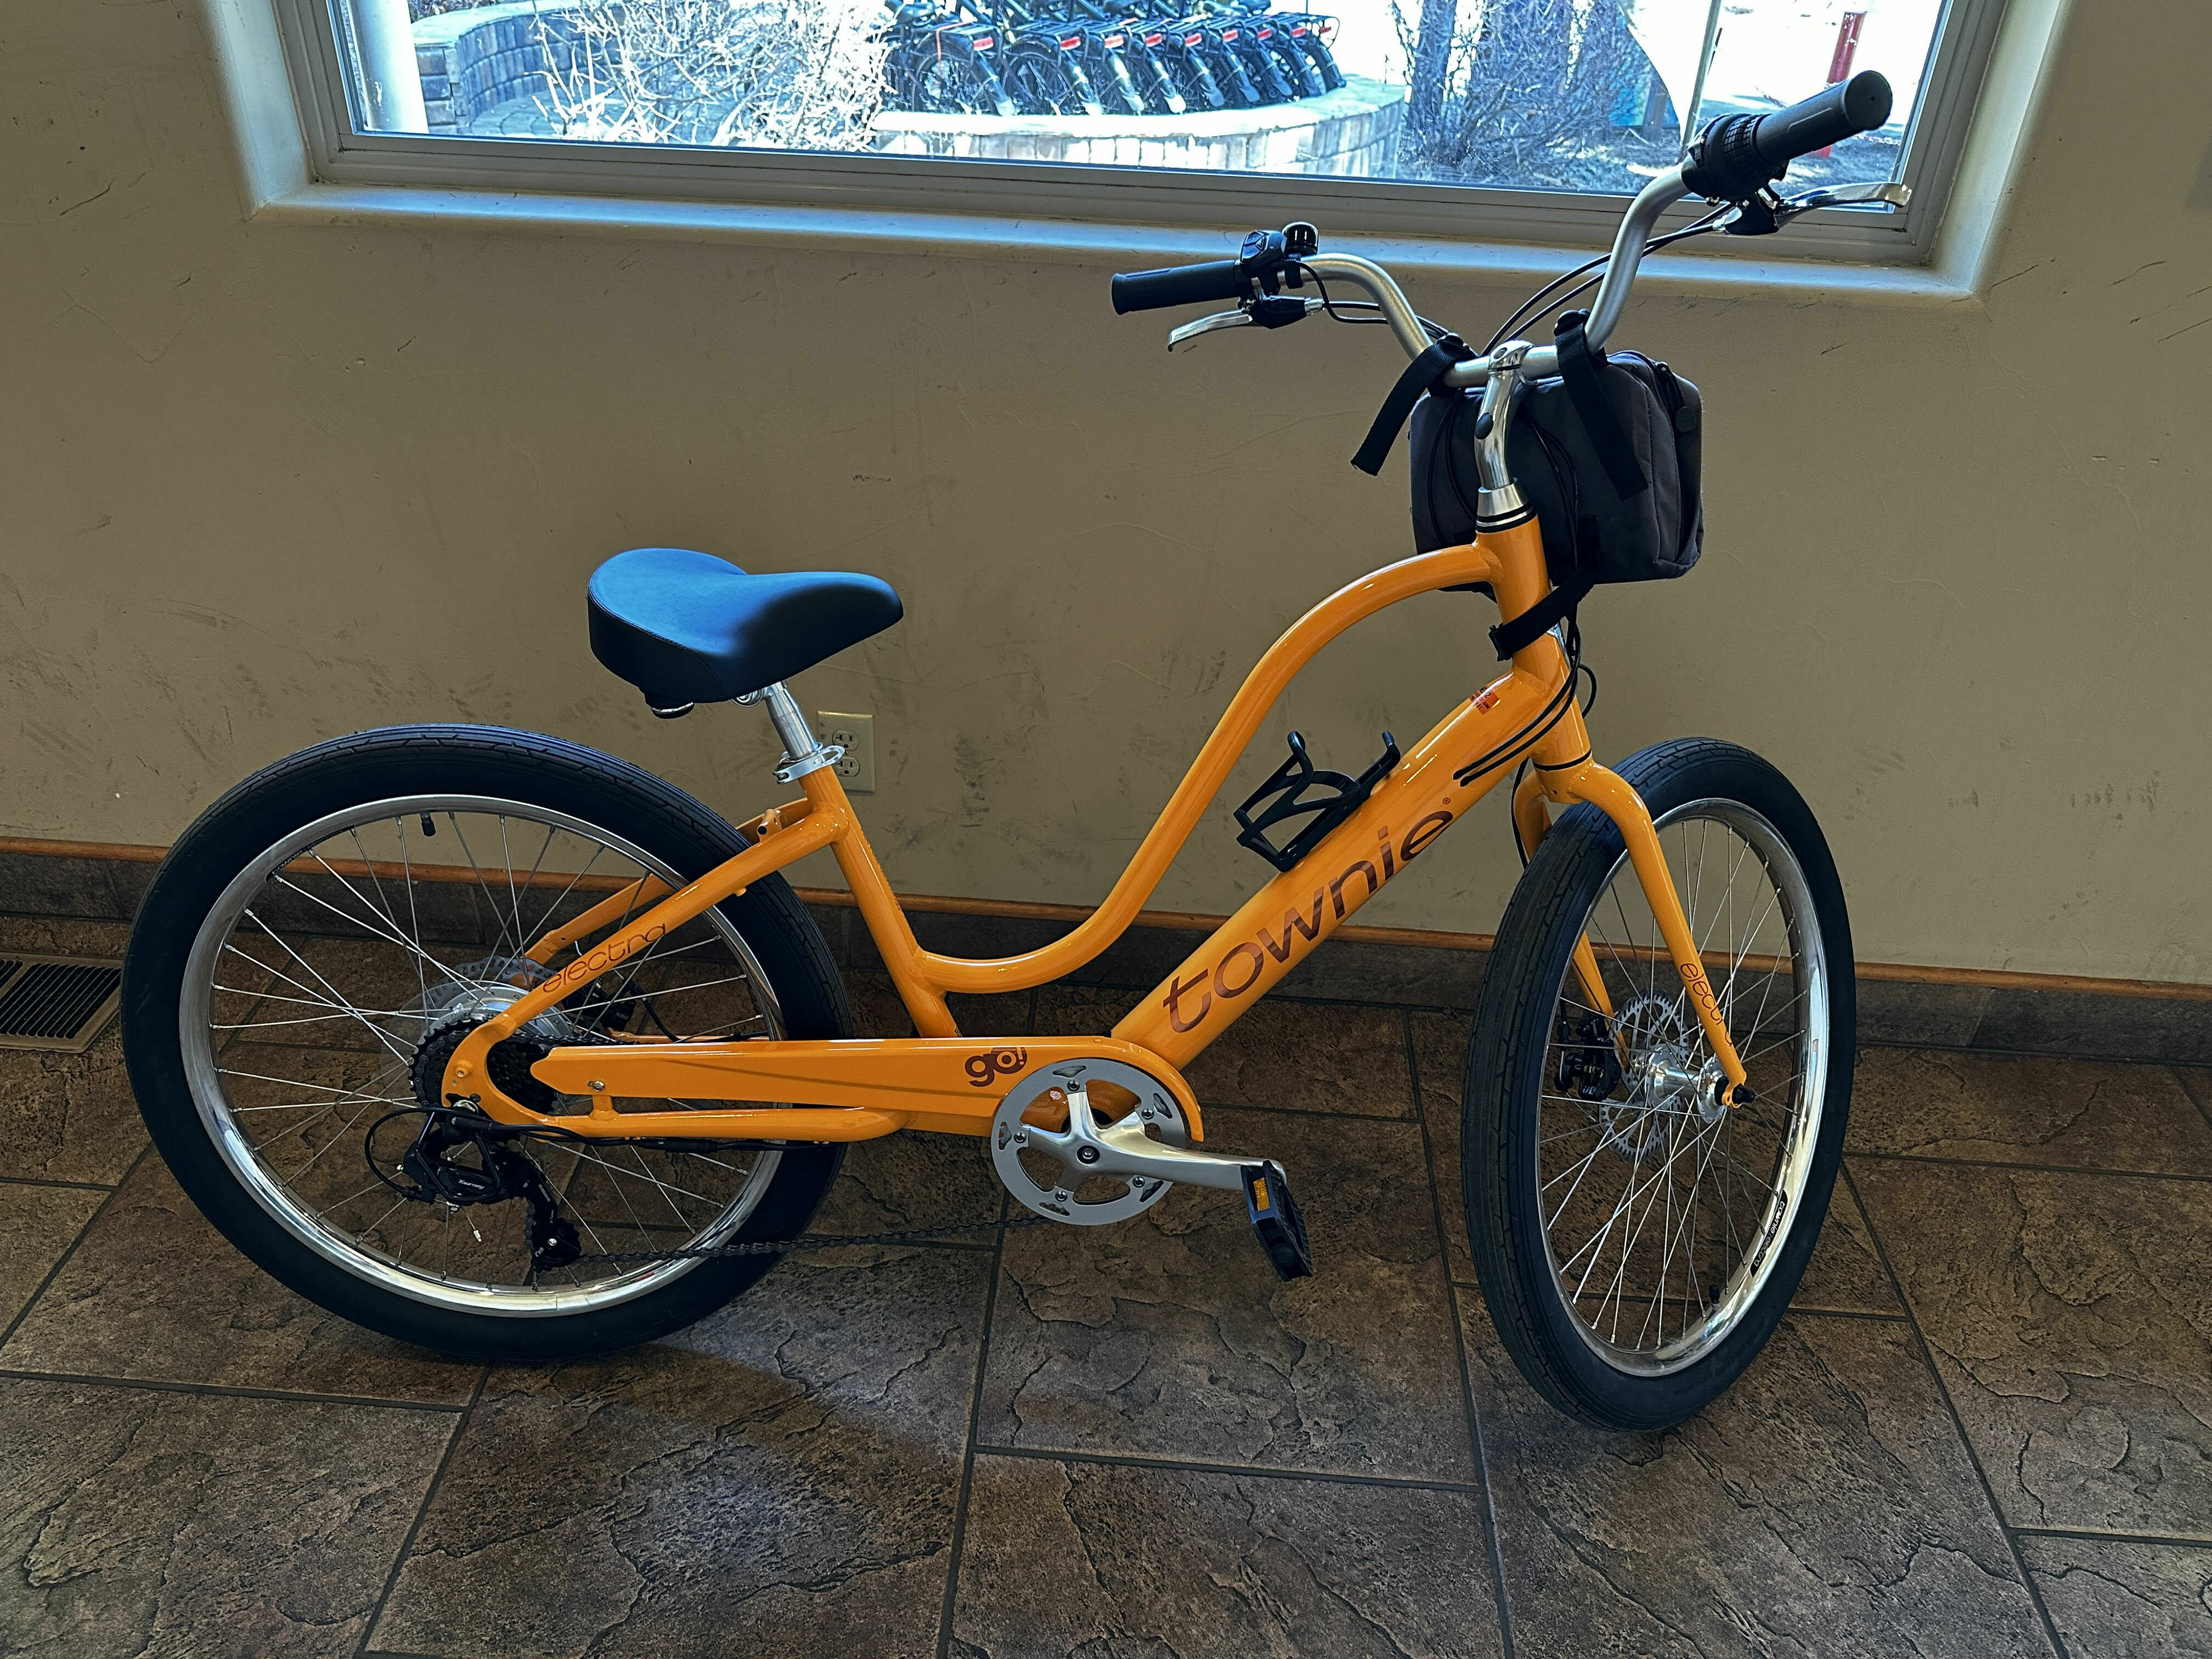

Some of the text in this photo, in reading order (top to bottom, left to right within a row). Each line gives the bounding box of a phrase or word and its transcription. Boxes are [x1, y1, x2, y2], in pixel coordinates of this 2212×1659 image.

[1163, 811, 1453, 1033] townie
[543, 923, 665, 992] electra
[964, 1047, 1028, 1087] go!
[1770, 1201, 1785, 1234] townie
